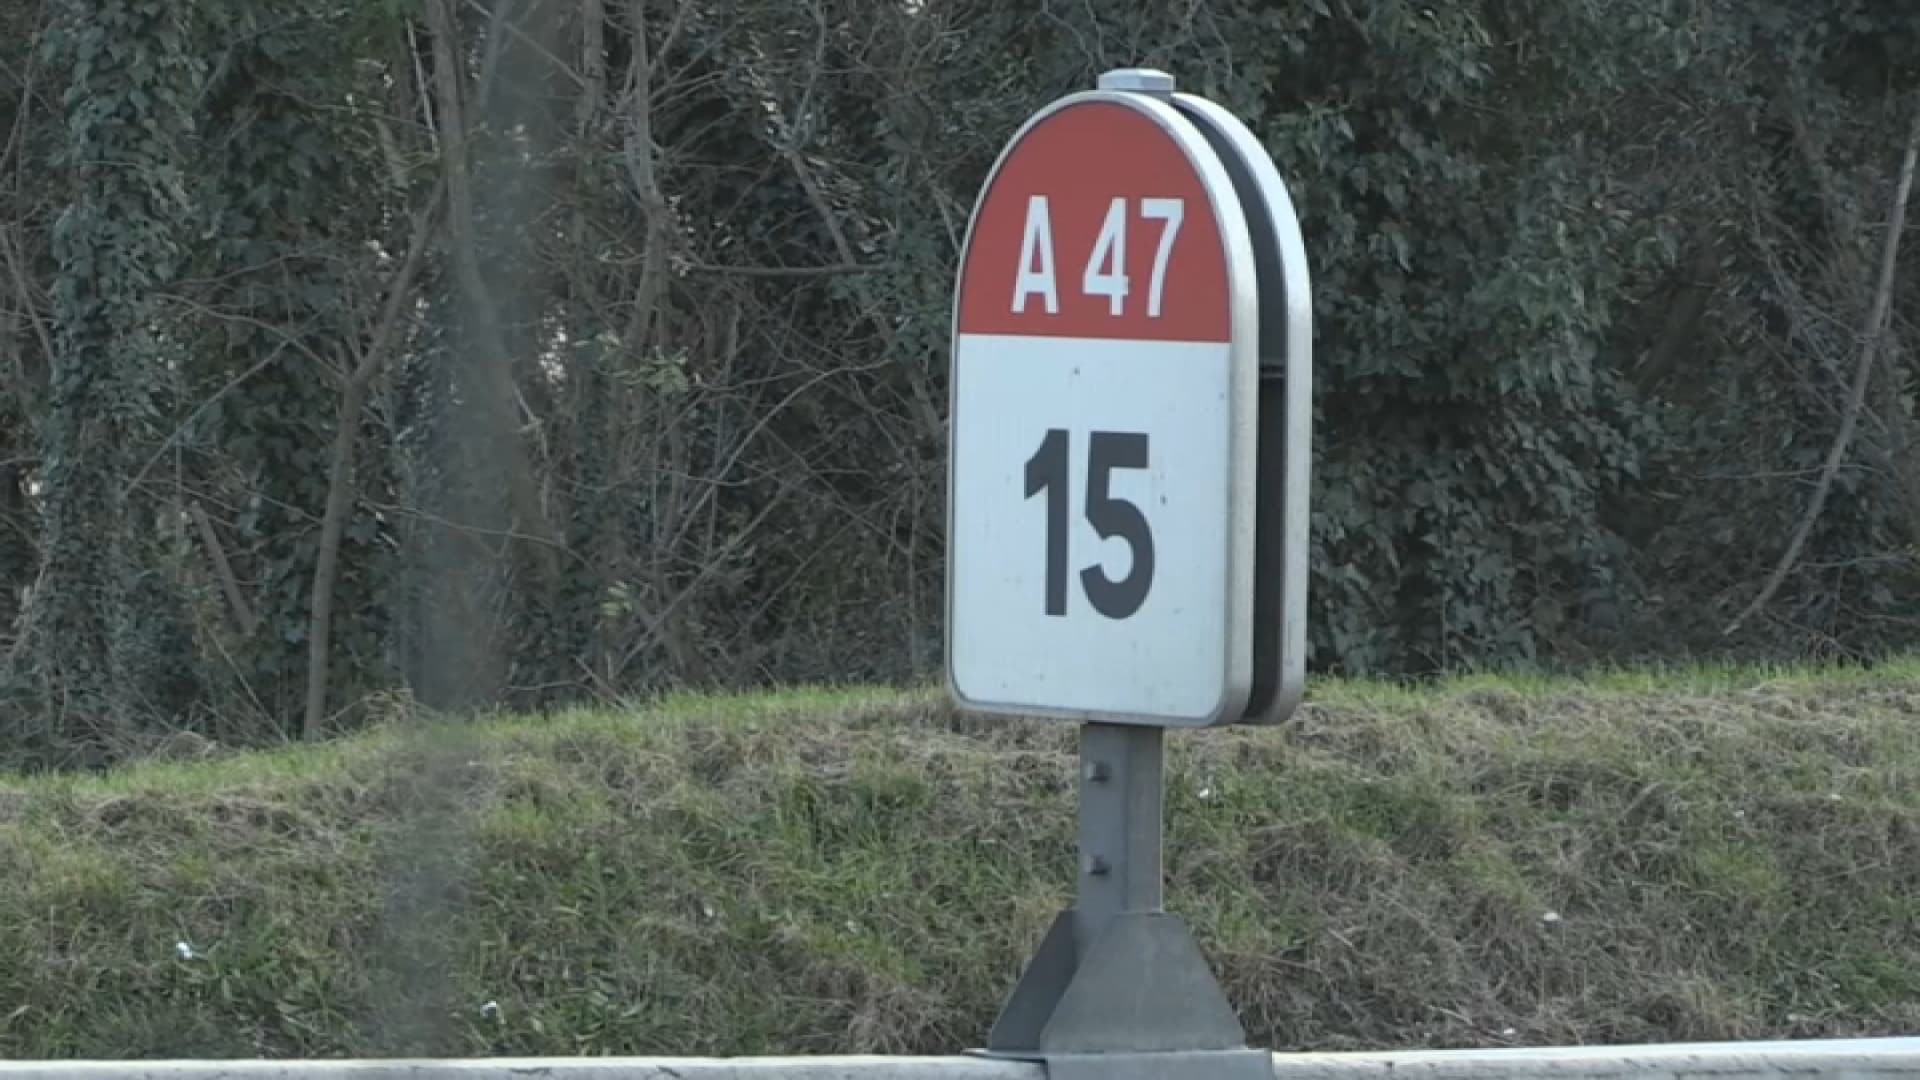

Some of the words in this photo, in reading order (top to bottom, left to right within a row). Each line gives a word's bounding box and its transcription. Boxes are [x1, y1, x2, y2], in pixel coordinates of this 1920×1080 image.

[1011, 195, 1059, 314] A
[1082, 197, 1185, 317] 47
[1023, 428, 1155, 620] 15
